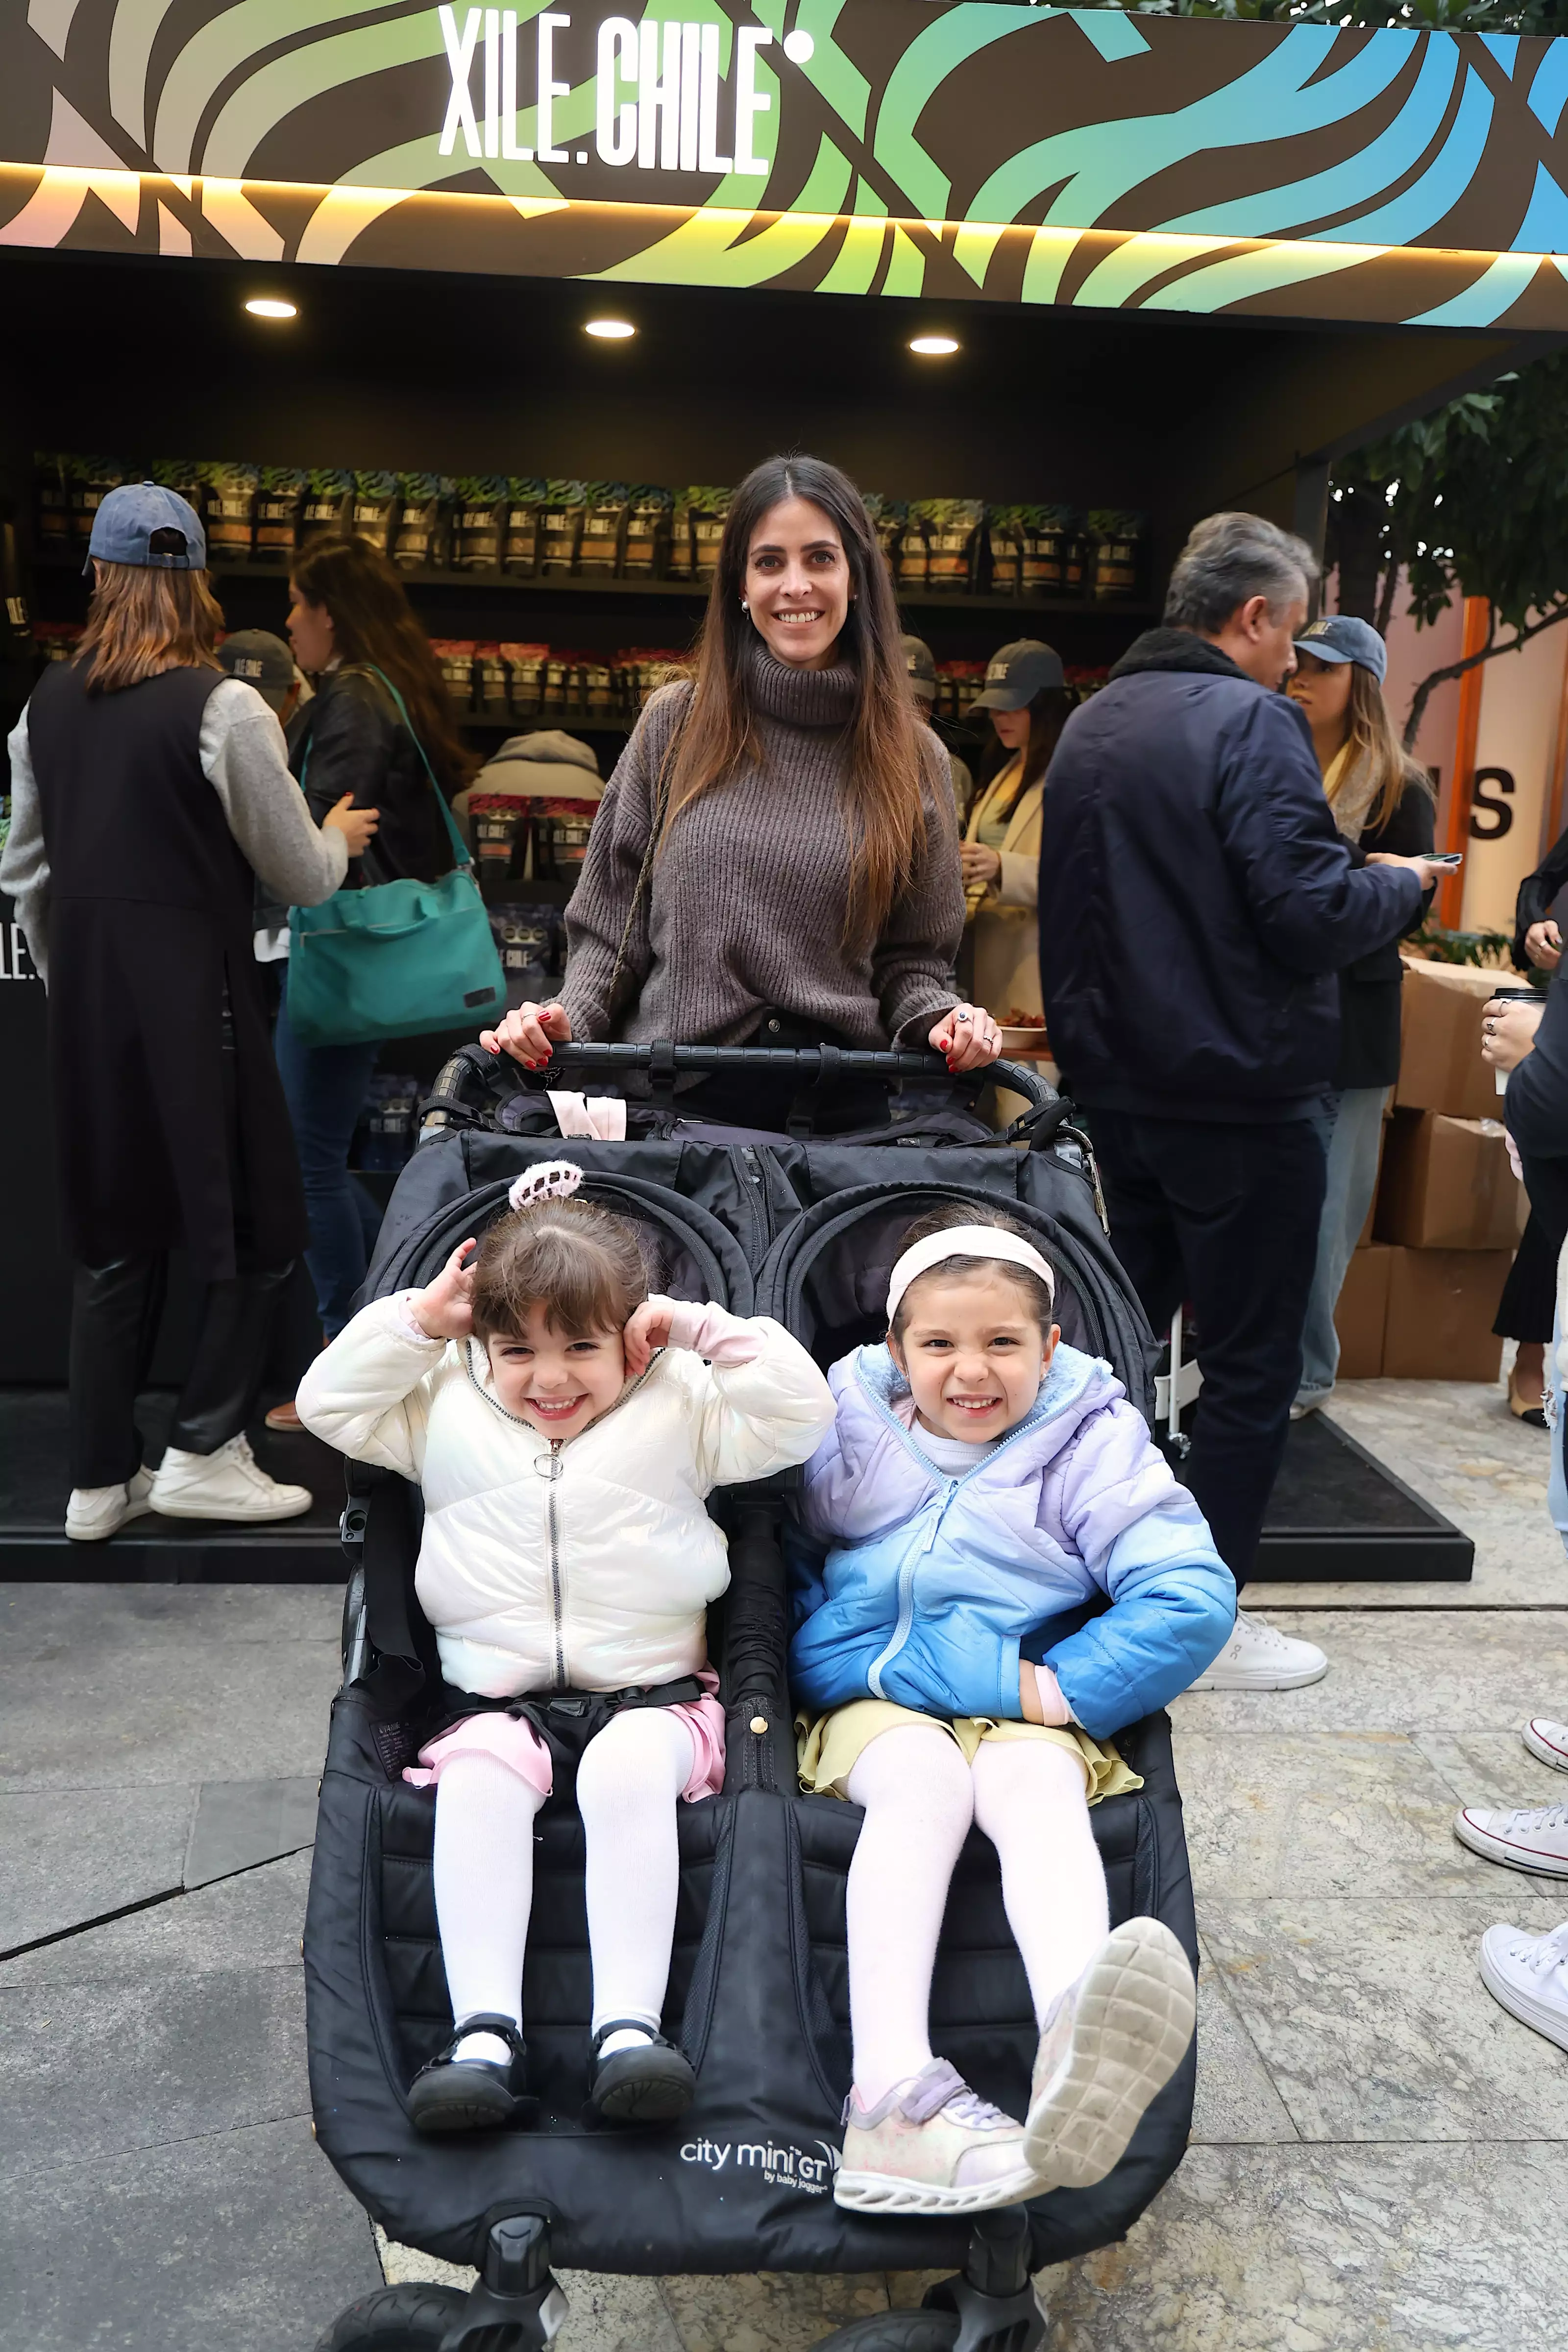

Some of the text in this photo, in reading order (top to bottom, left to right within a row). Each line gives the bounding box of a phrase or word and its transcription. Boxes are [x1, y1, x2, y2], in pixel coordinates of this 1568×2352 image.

[679, 2137, 732, 2171] city
[798, 2156, 828, 2181] GT
[764, 2170, 776, 2183] by
[777, 2173, 798, 2188] baby
